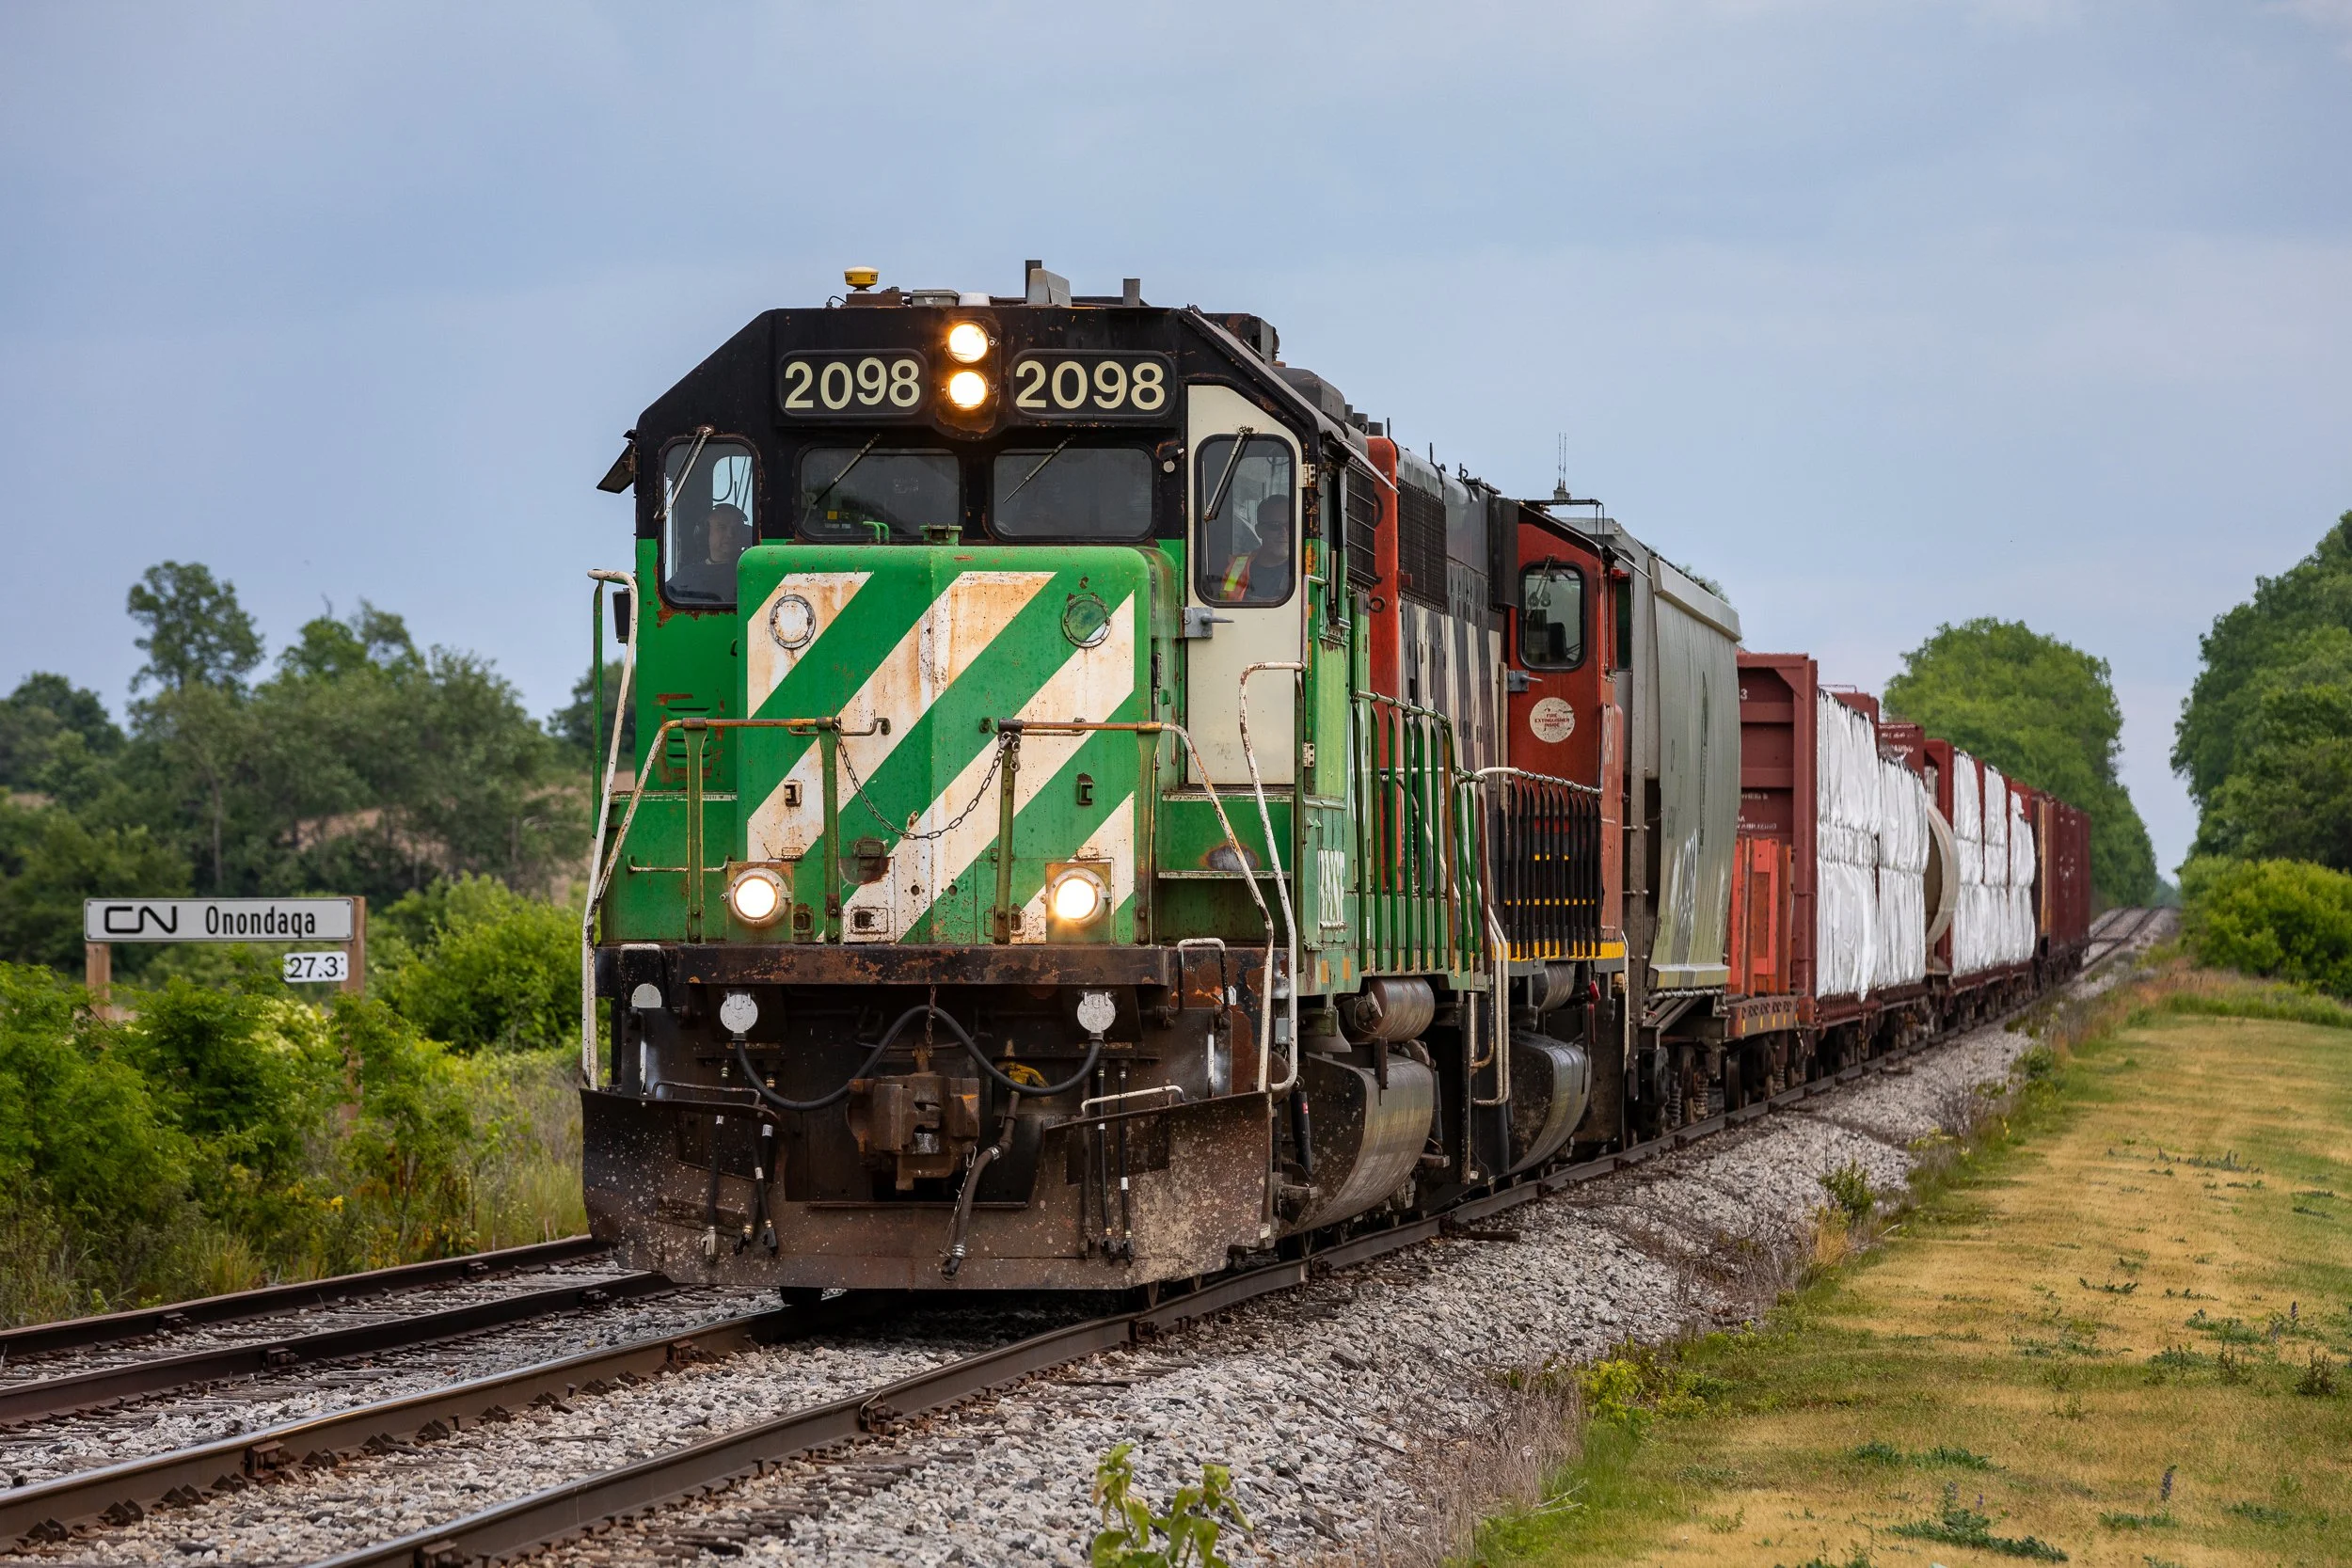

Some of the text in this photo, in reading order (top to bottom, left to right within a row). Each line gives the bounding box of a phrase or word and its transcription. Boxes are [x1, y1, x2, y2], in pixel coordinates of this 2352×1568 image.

[785, 357, 920, 410] 2098
[1015, 359, 1166, 411] 2098
[103, 905, 178, 934] CN
[289, 956, 339, 978] 27.3
